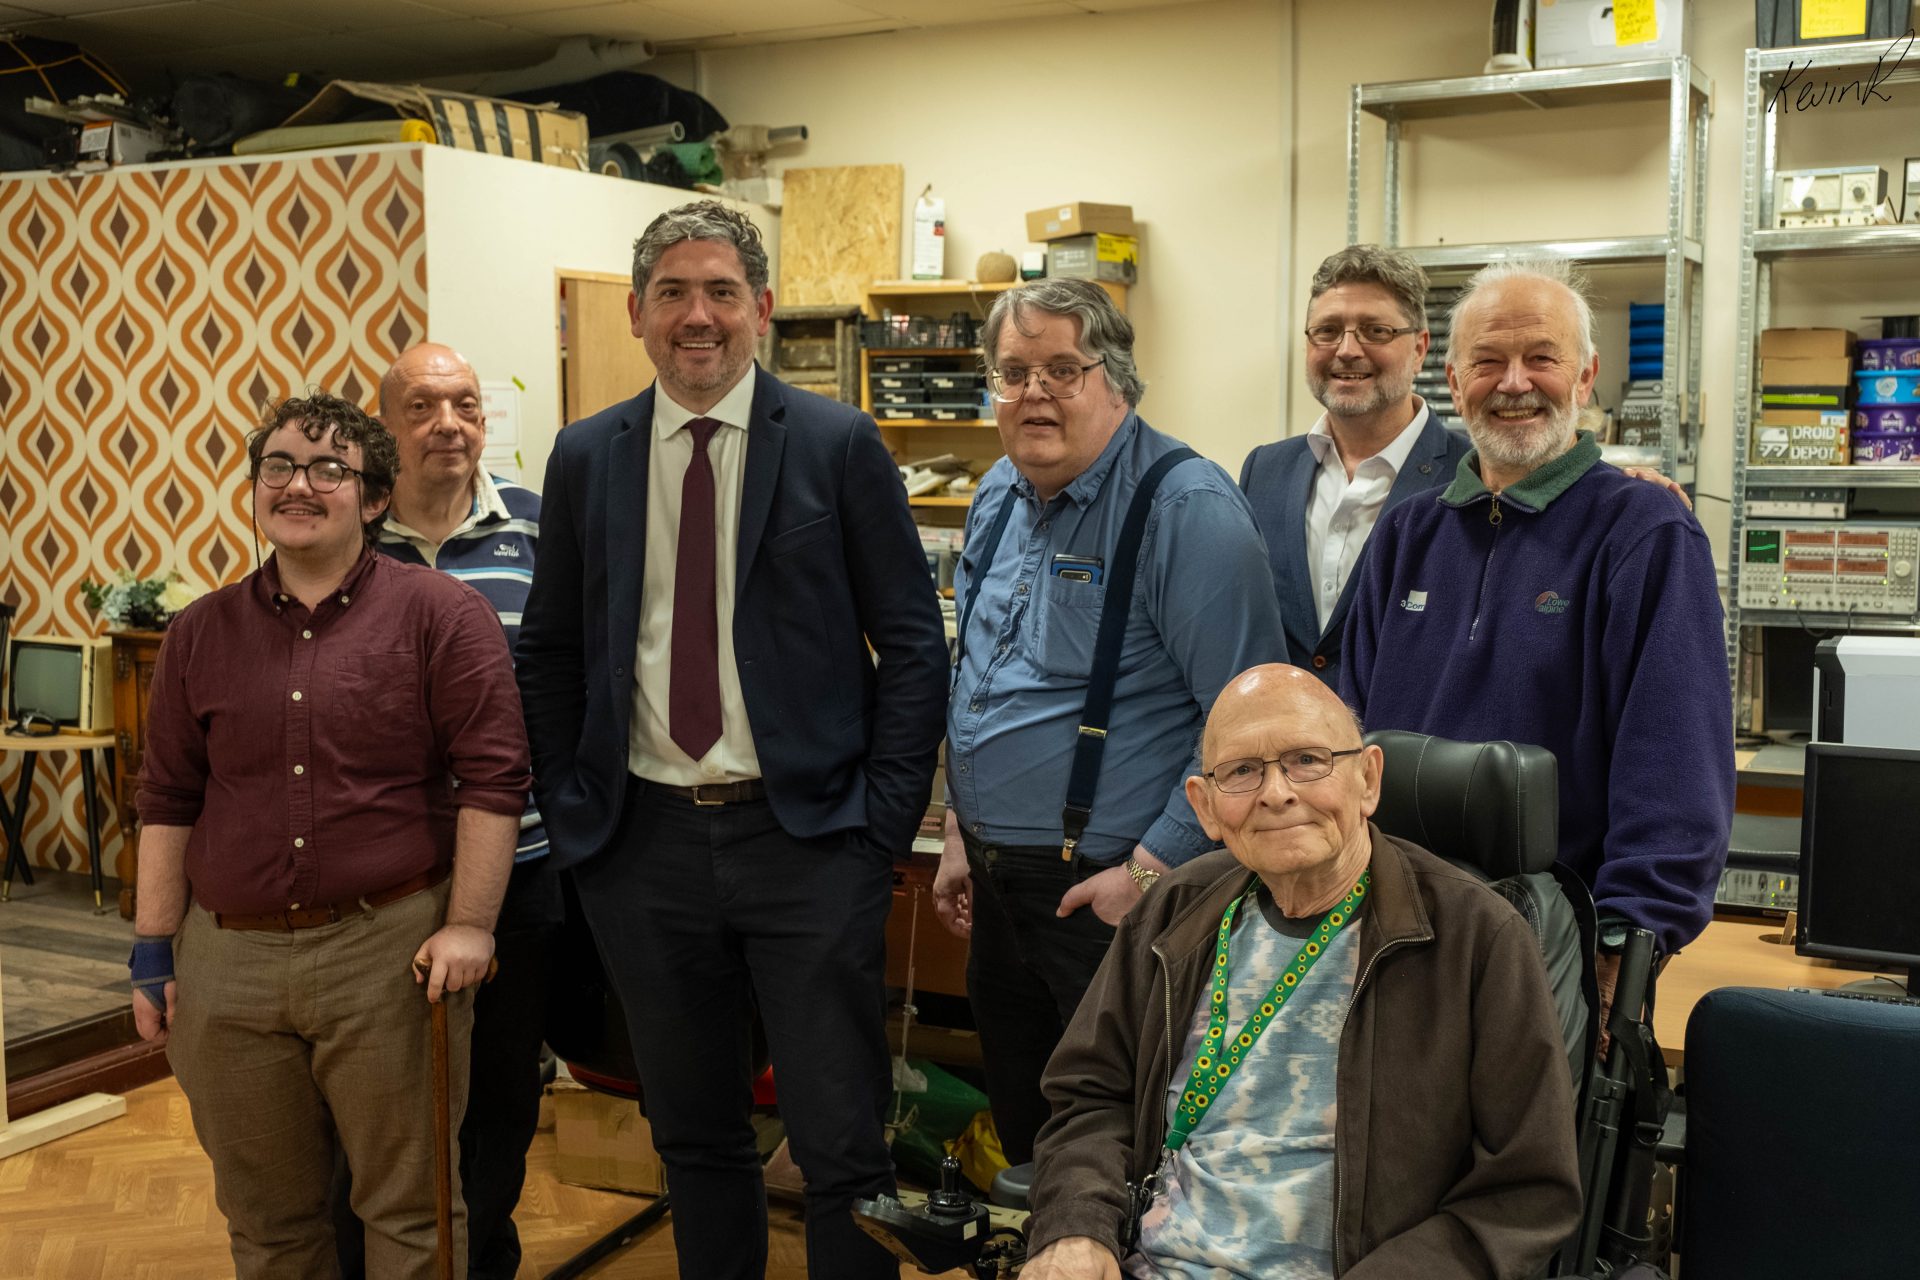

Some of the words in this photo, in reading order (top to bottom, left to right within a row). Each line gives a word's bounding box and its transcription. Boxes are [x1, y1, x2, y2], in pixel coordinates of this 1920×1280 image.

[1792, 426, 1836, 440] DROID
[1791, 446, 1836, 460] DEPOT
[1547, 597, 1570, 607] Lowe
